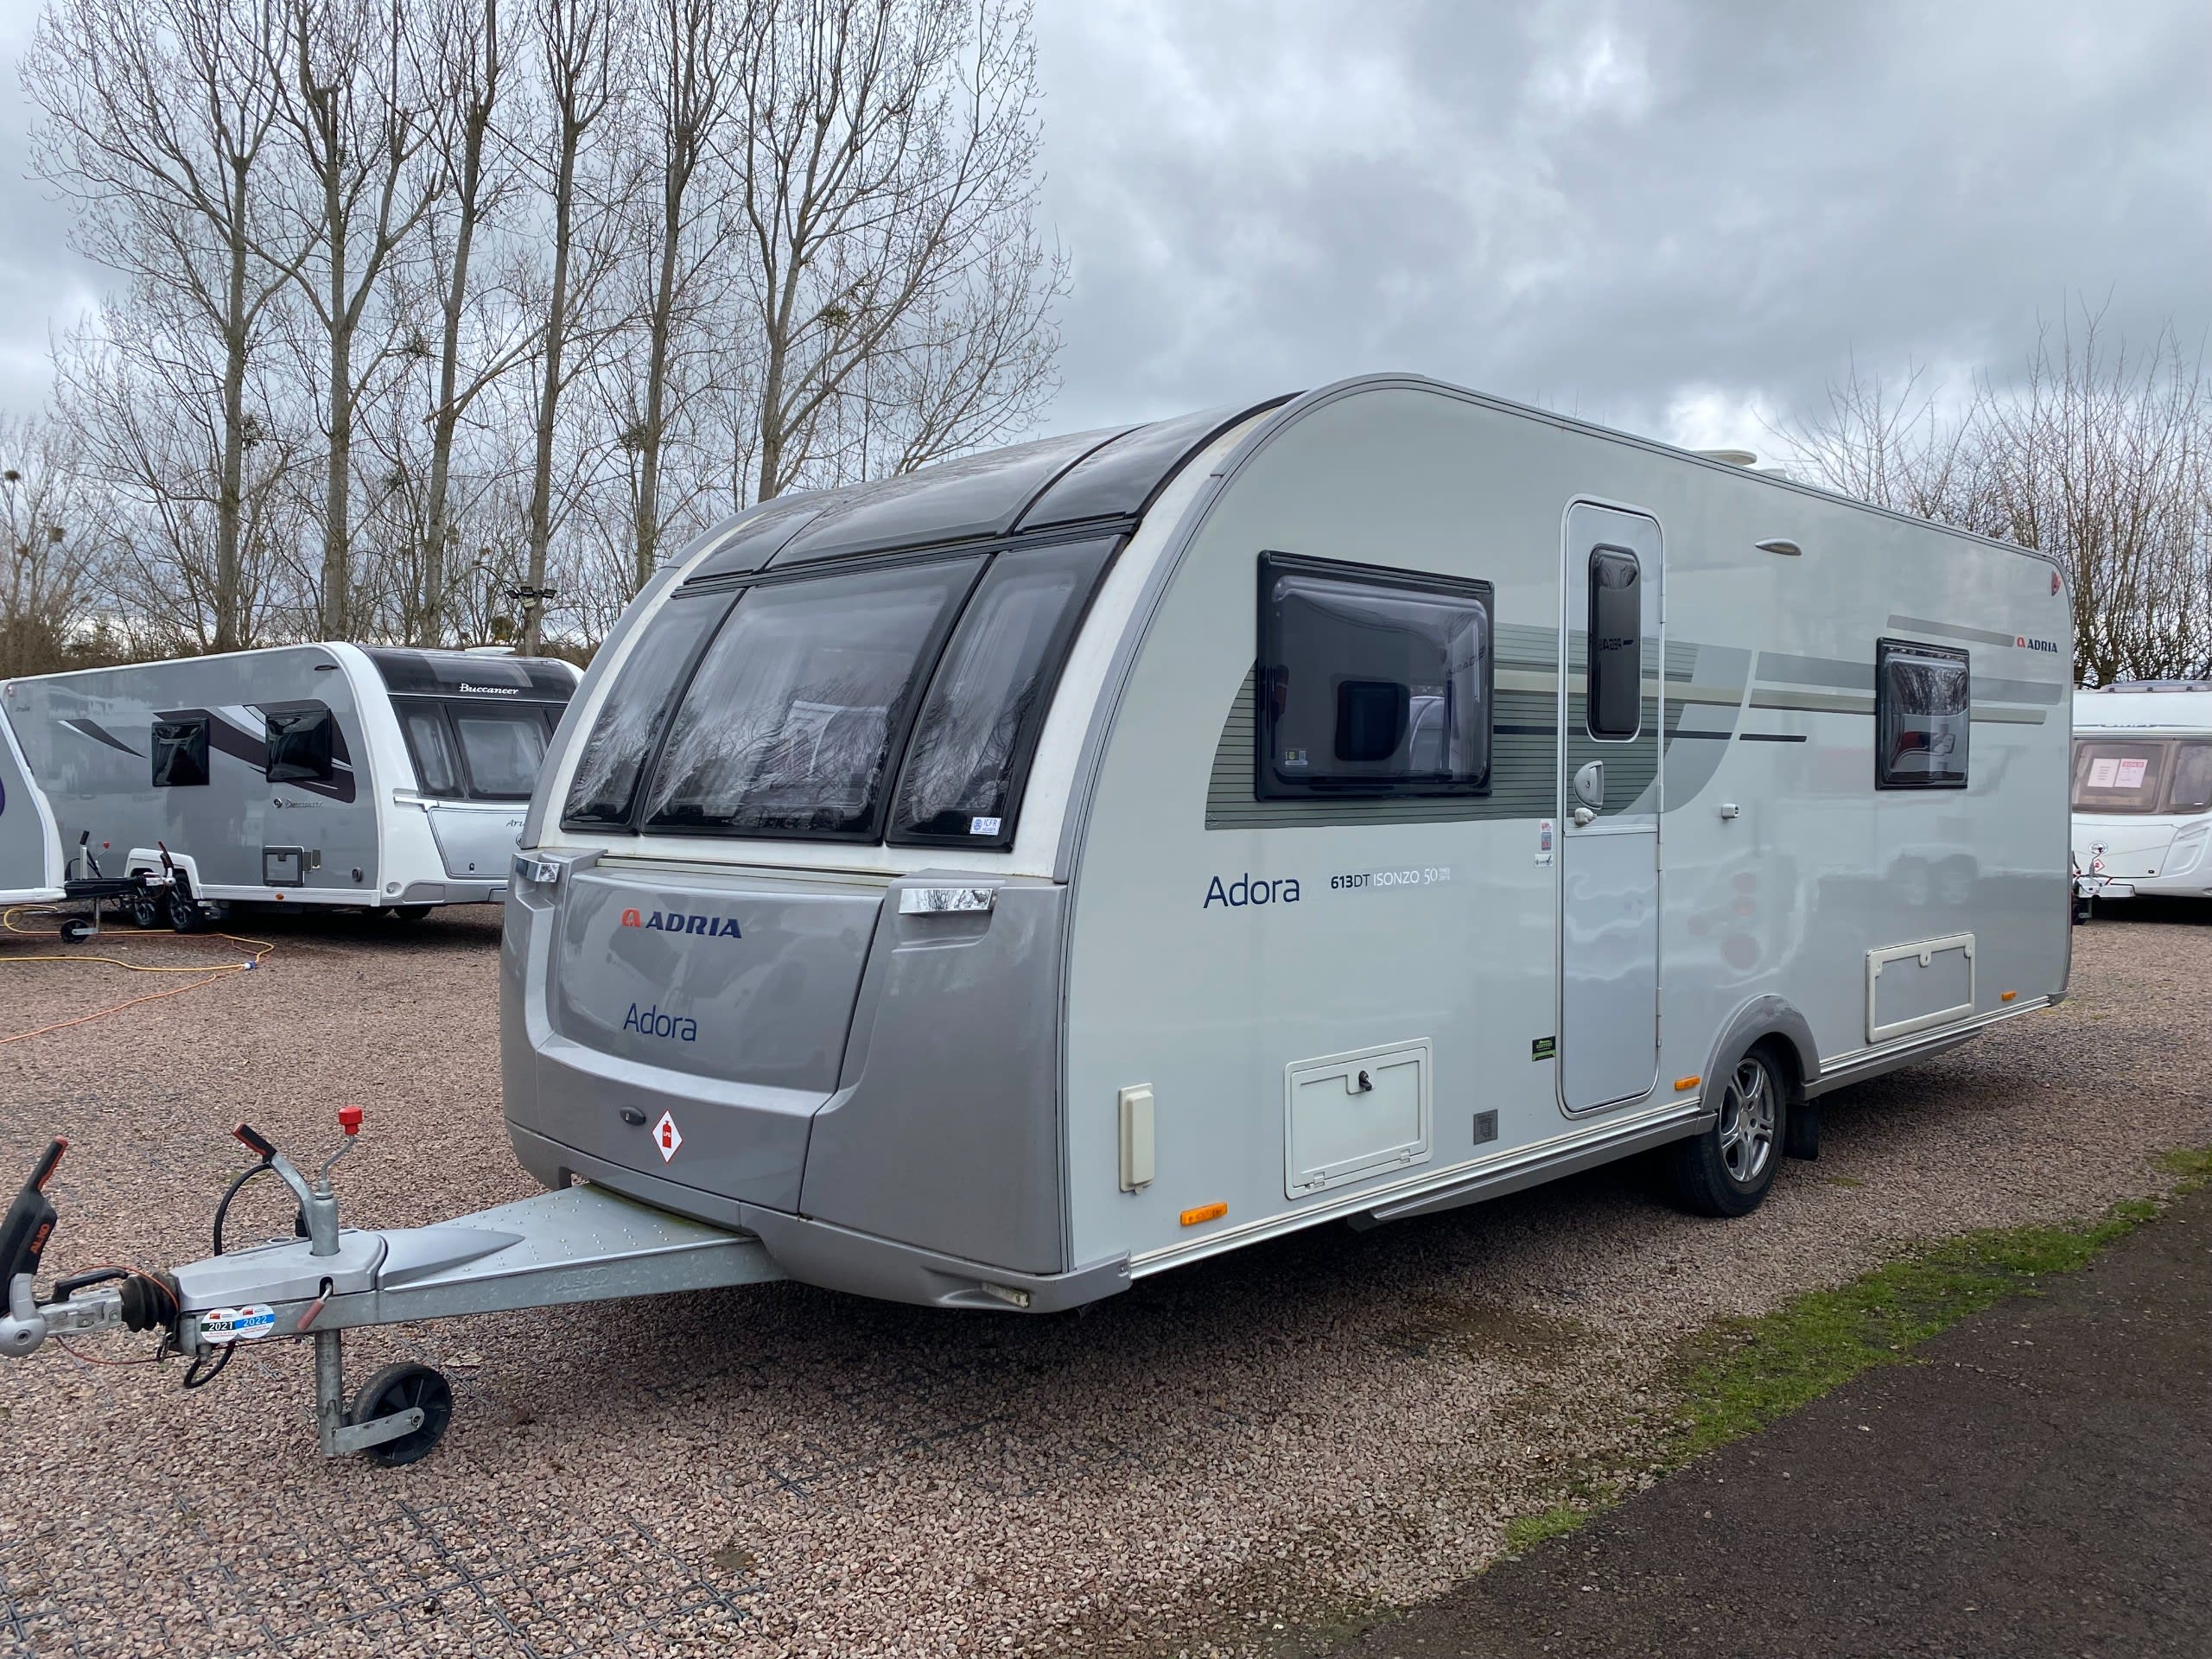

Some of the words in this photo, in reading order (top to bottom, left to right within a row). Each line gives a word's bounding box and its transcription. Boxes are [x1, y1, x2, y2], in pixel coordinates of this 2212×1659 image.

[2028, 639, 2058, 653] ADRIA
[459, 683, 518, 695] Buccaneer
[1331, 874, 1370, 889] 613DT
[1373, 870, 1420, 887] ISONZO
[1424, 868, 1438, 885] 50
[1203, 873, 1300, 908] Adora
[645, 911, 742, 939] ADRIA
[623, 1002, 697, 1042] Adora
[208, 1321, 234, 1332] 2021
[243, 1315, 268, 1327] 2022
